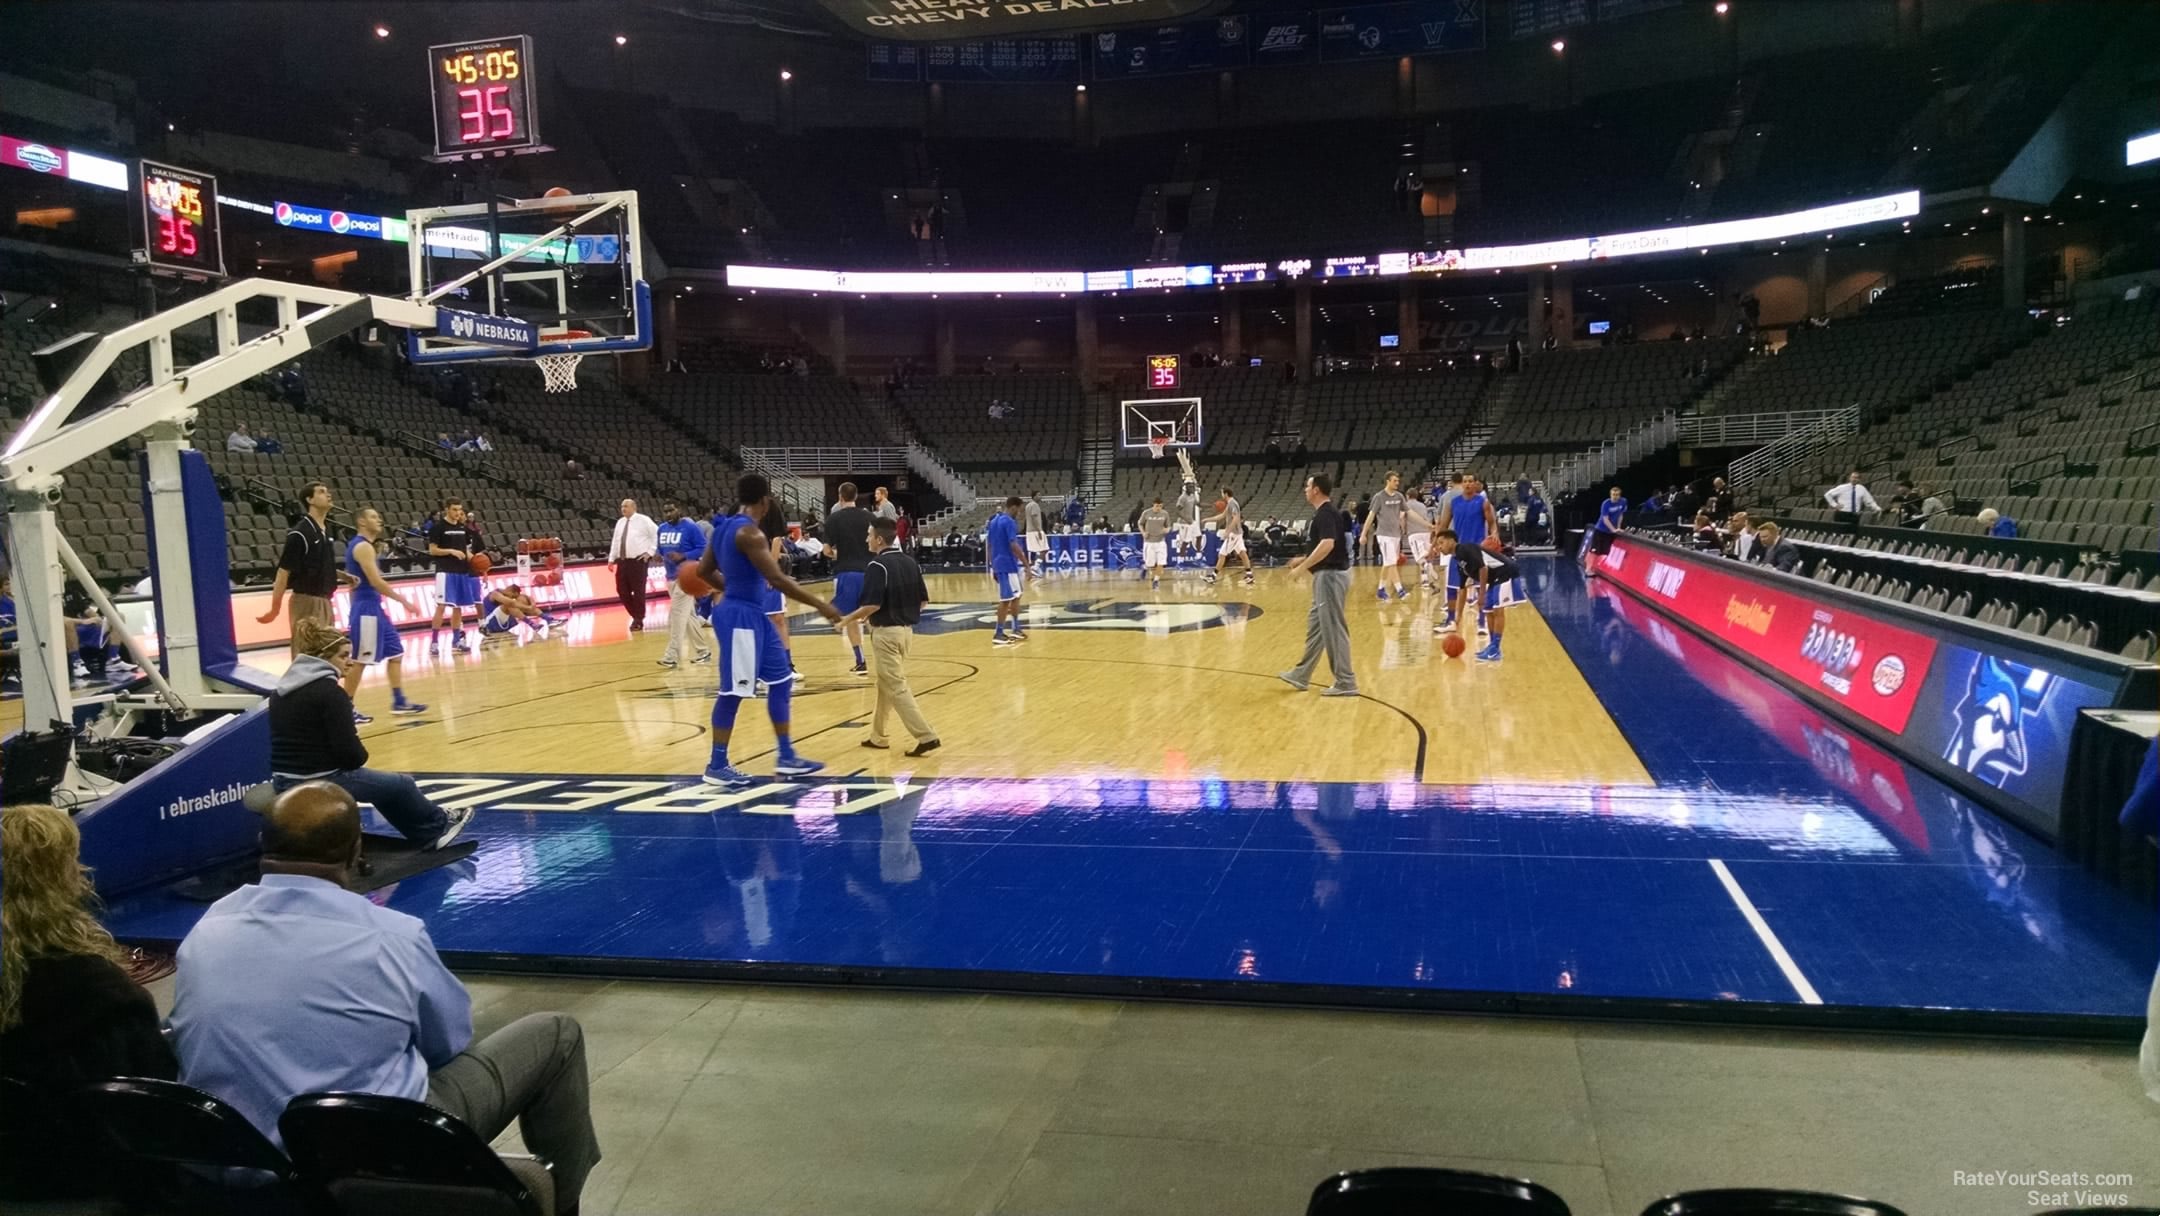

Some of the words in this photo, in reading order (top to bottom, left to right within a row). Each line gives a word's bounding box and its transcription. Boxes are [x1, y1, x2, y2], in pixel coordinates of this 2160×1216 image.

[866, 6, 990, 26] CHEVY
[1268, 25, 1299, 37] BIG
[1262, 34, 1308, 47] EAST
[444, 50, 519, 84] 45:05
[459, 86, 513, 140] 35
[152, 167, 202, 185] DAKTRONICS
[294, 211, 323, 224] pepsi
[351, 218, 380, 232] pepsi
[159, 214, 197, 255] 35
[426, 229, 480, 242] meritrade
[475, 323, 529, 343] NEBRASKA
[1151, 357, 1177, 368] 45:05
[1155, 368, 1175, 385] 35
[659, 531, 682, 545] EIU
[1045, 550, 1104, 564] CAGE
